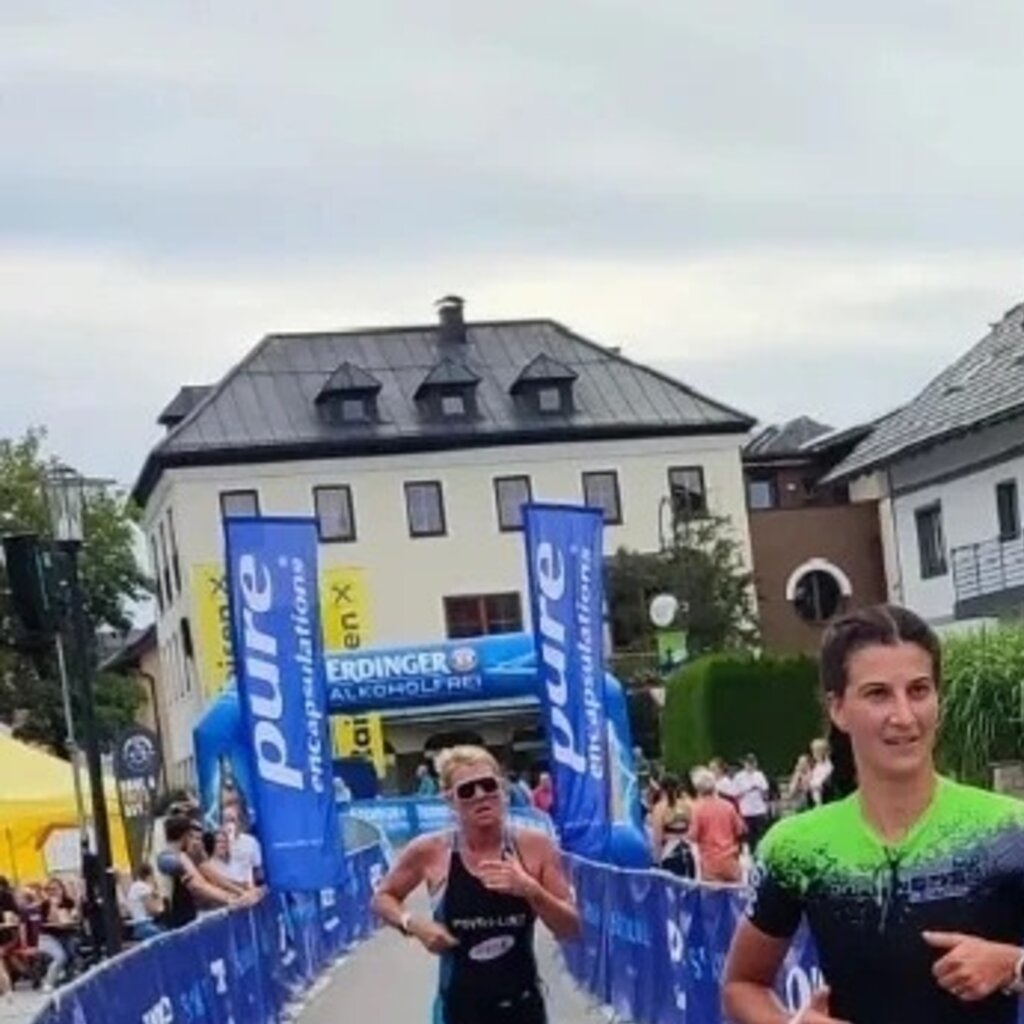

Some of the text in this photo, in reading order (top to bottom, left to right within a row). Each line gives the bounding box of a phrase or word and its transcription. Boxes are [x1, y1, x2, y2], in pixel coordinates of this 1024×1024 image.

[239, 554, 304, 790] pure
[291, 556, 325, 793] encapsulations
[326, 652, 451, 683] ERDINGER
[329, 675, 483, 701] ALKOHOLFREI
[536, 541, 587, 774] pure
